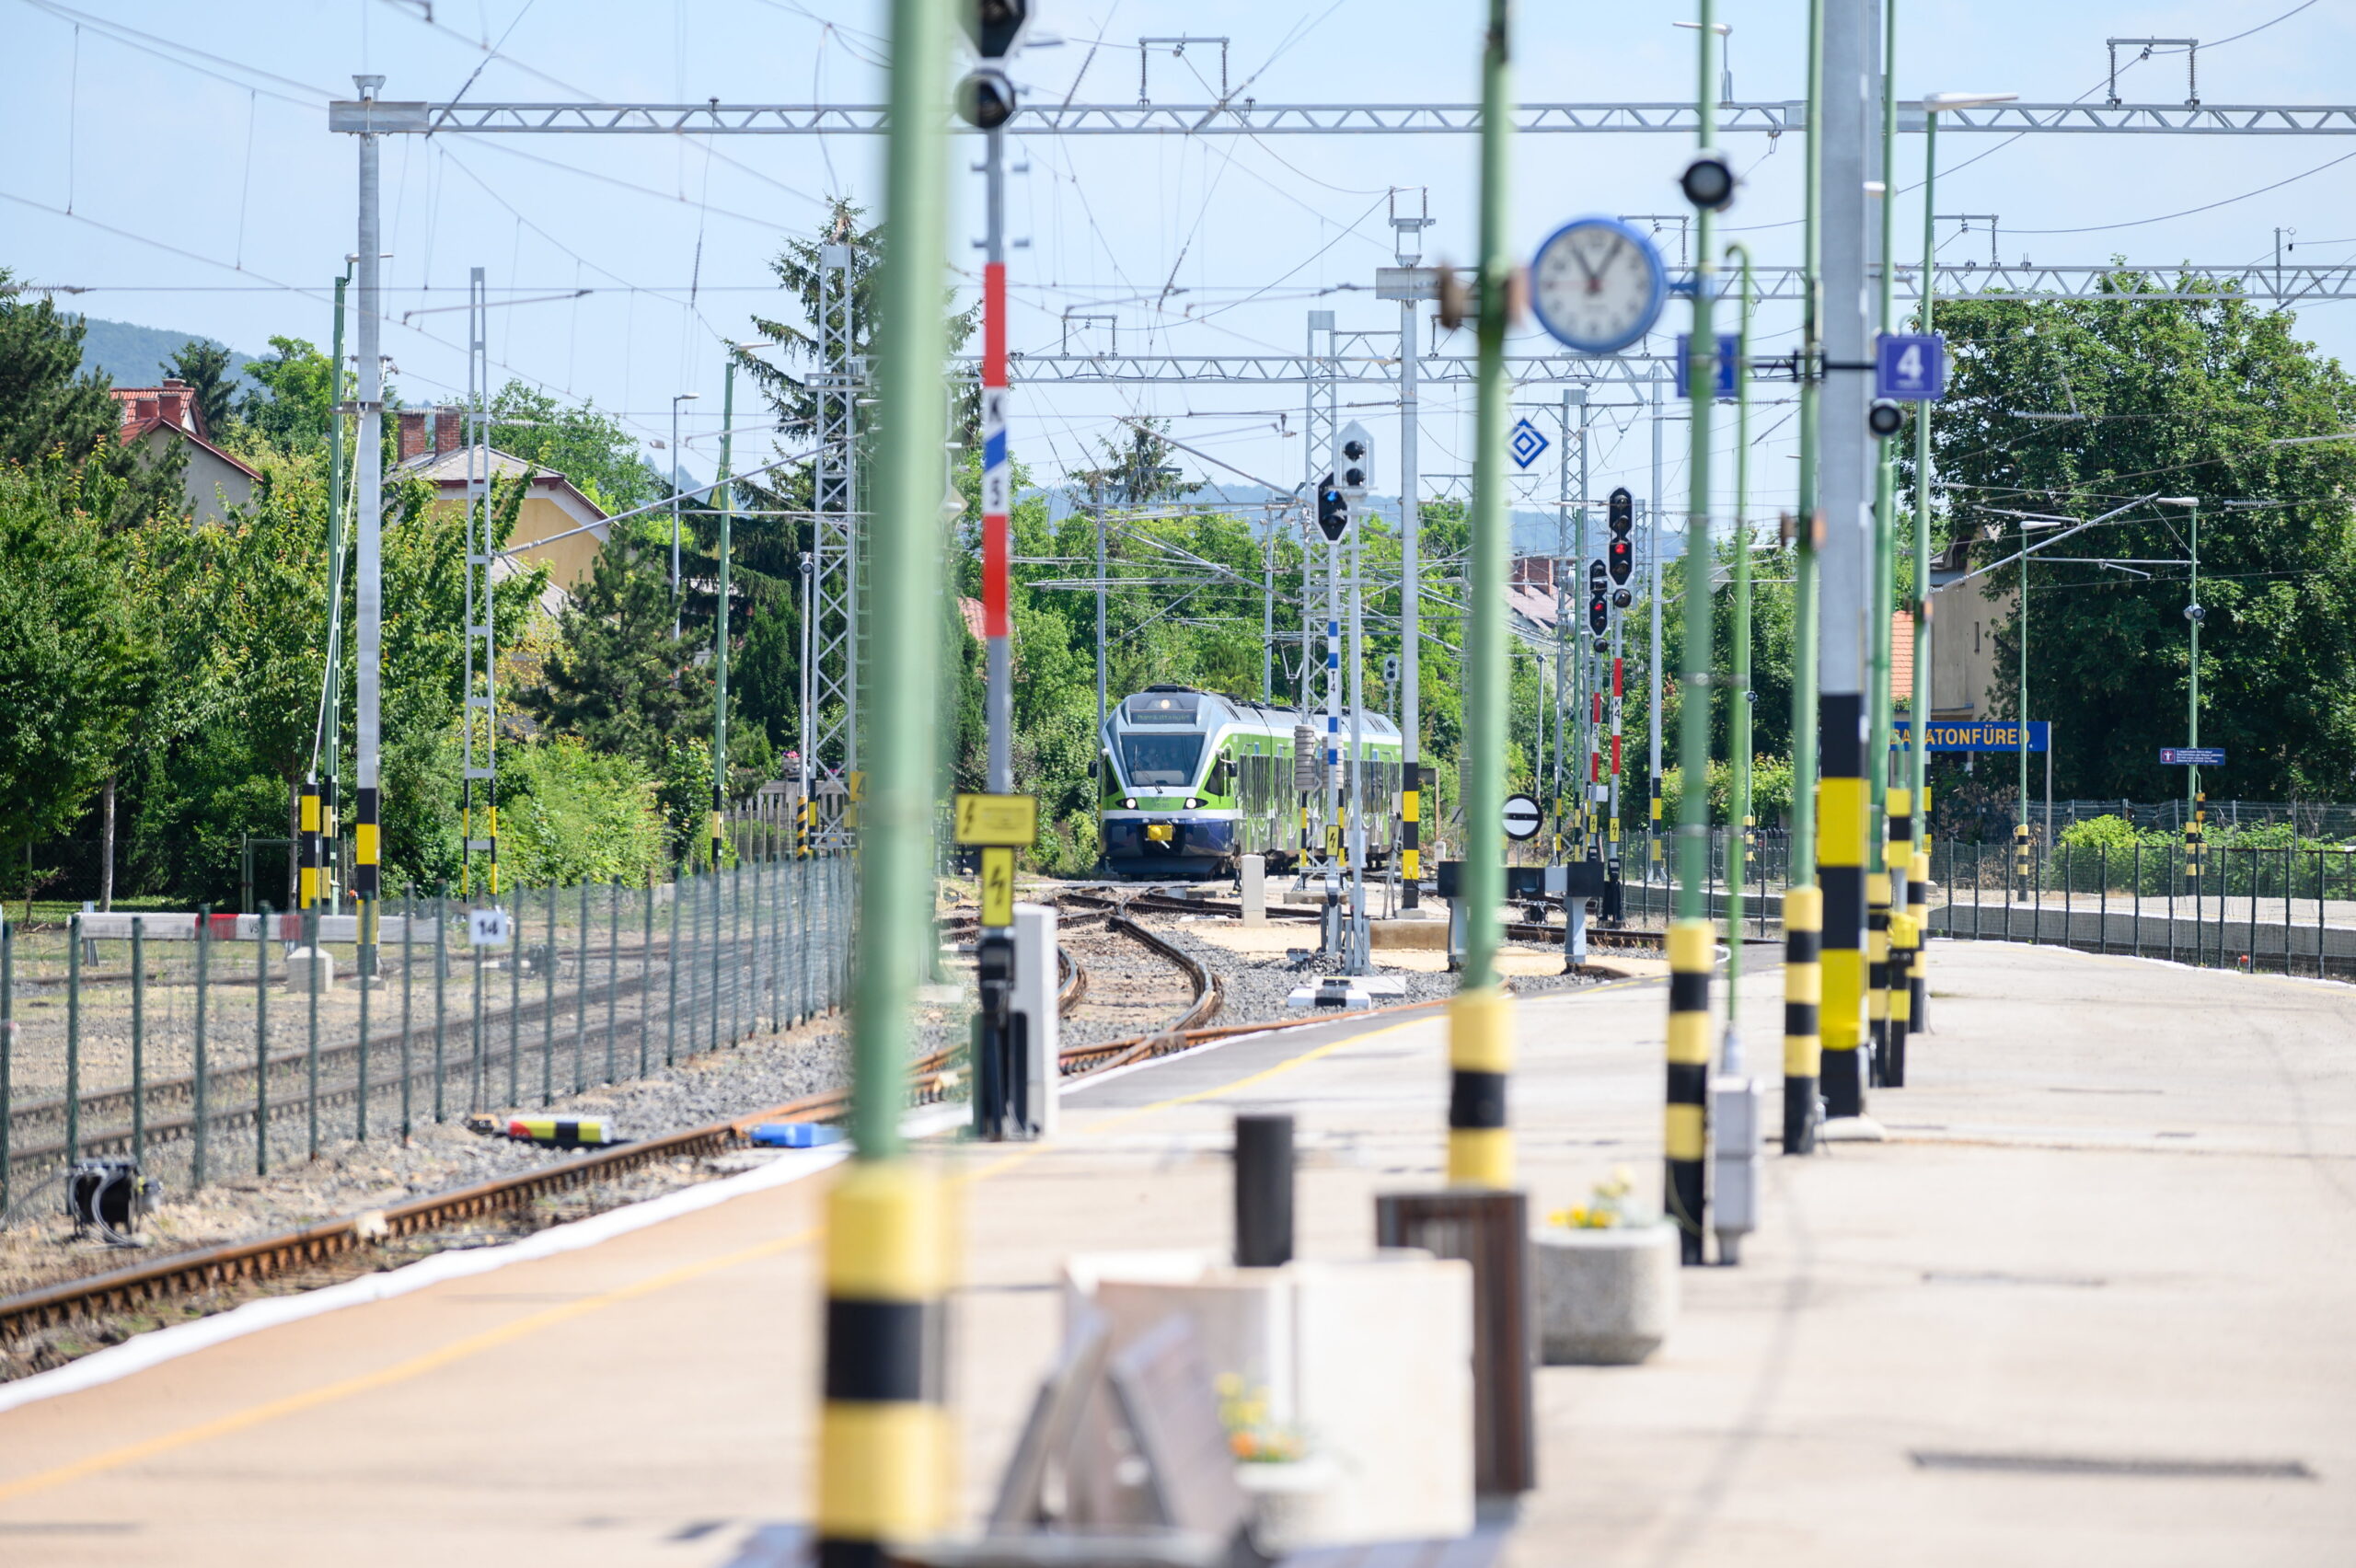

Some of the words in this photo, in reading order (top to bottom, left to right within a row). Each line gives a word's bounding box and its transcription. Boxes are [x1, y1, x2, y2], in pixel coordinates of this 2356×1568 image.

[1896, 344, 1924, 378] 4
[988, 393, 1002, 422] K
[1614, 698, 1621, 720] K4
[1889, 724, 2030, 744] BAATONFÜRED
[477, 917, 499, 936] 14
